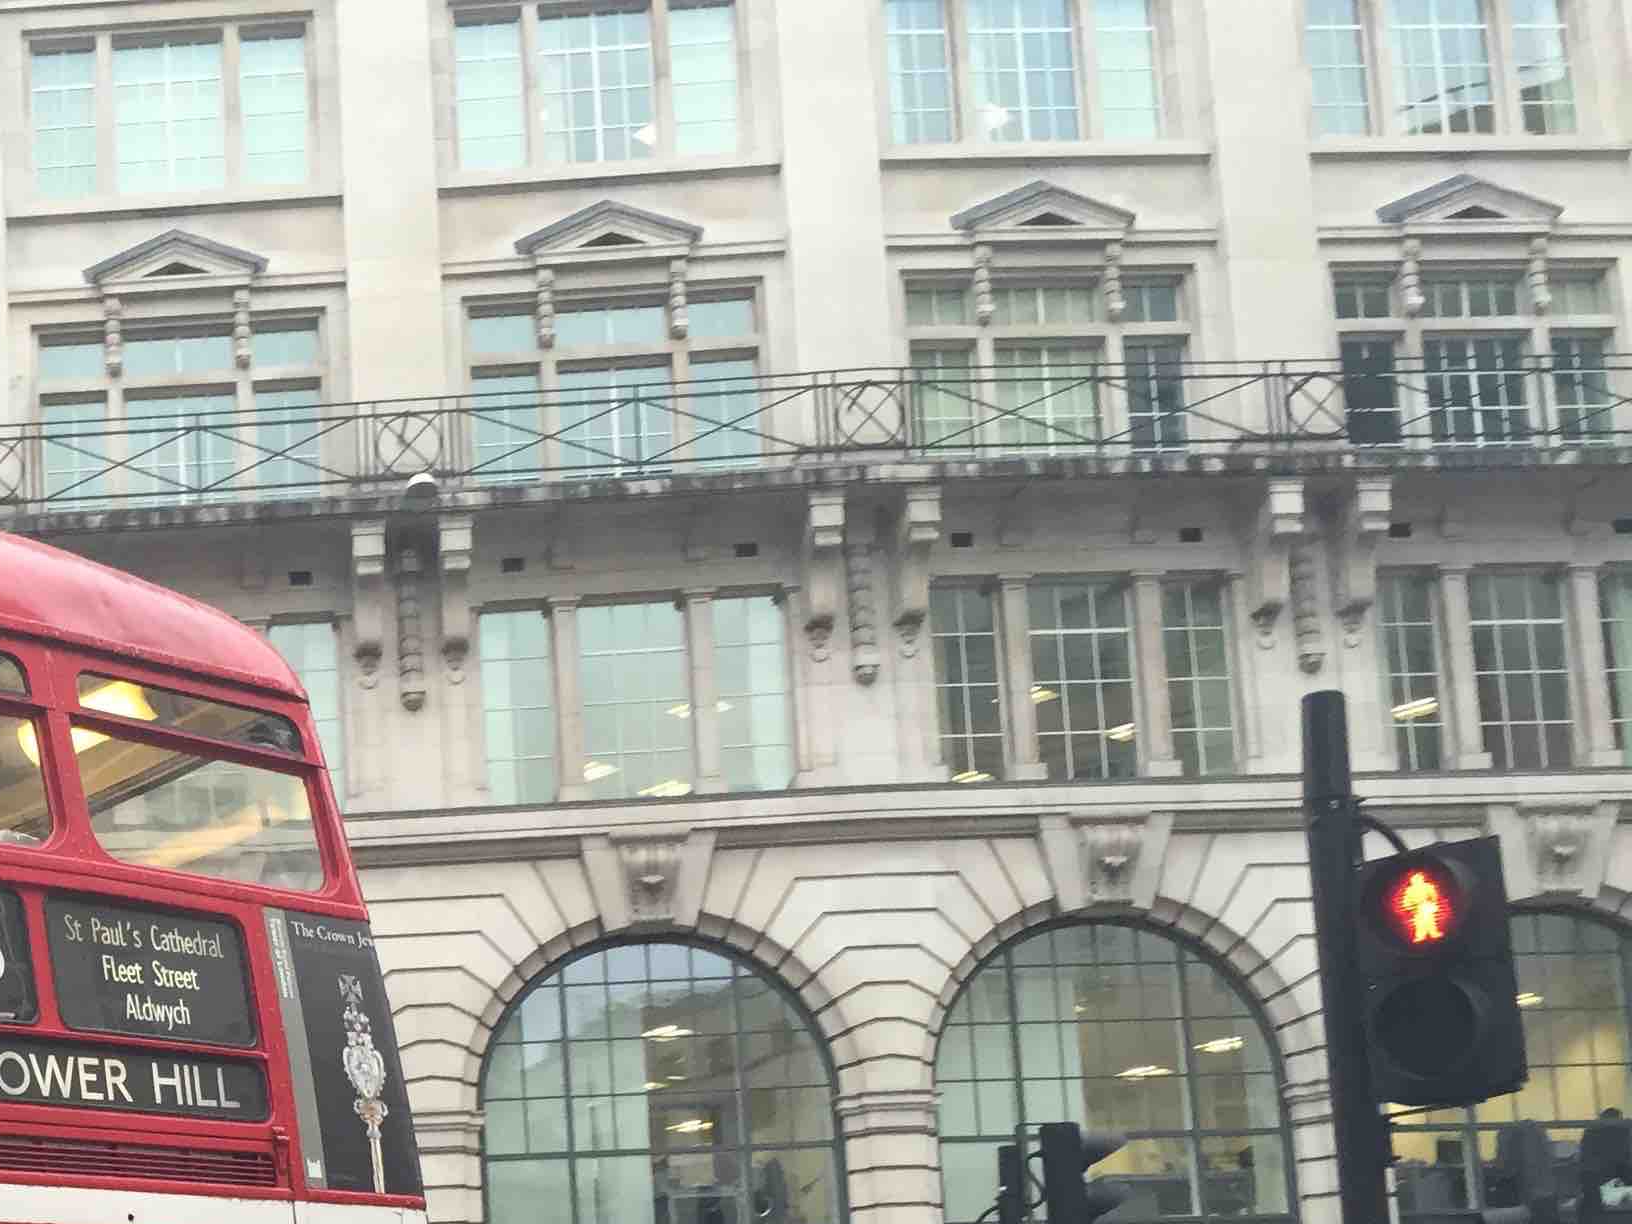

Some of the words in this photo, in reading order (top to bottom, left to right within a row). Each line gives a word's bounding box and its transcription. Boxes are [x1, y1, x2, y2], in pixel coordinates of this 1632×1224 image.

[64, 913, 84, 942] St
[90, 916, 143, 949] Paul's
[150, 924, 225, 959] Cathedral
[290, 920, 315, 938] The
[316, 925, 356, 945] Crown
[101, 954, 145, 985] Fleet
[151, 960, 201, 991] Street
[125, 993, 192, 1032] Aldwych
[151, 1061, 241, 1109] HILL
